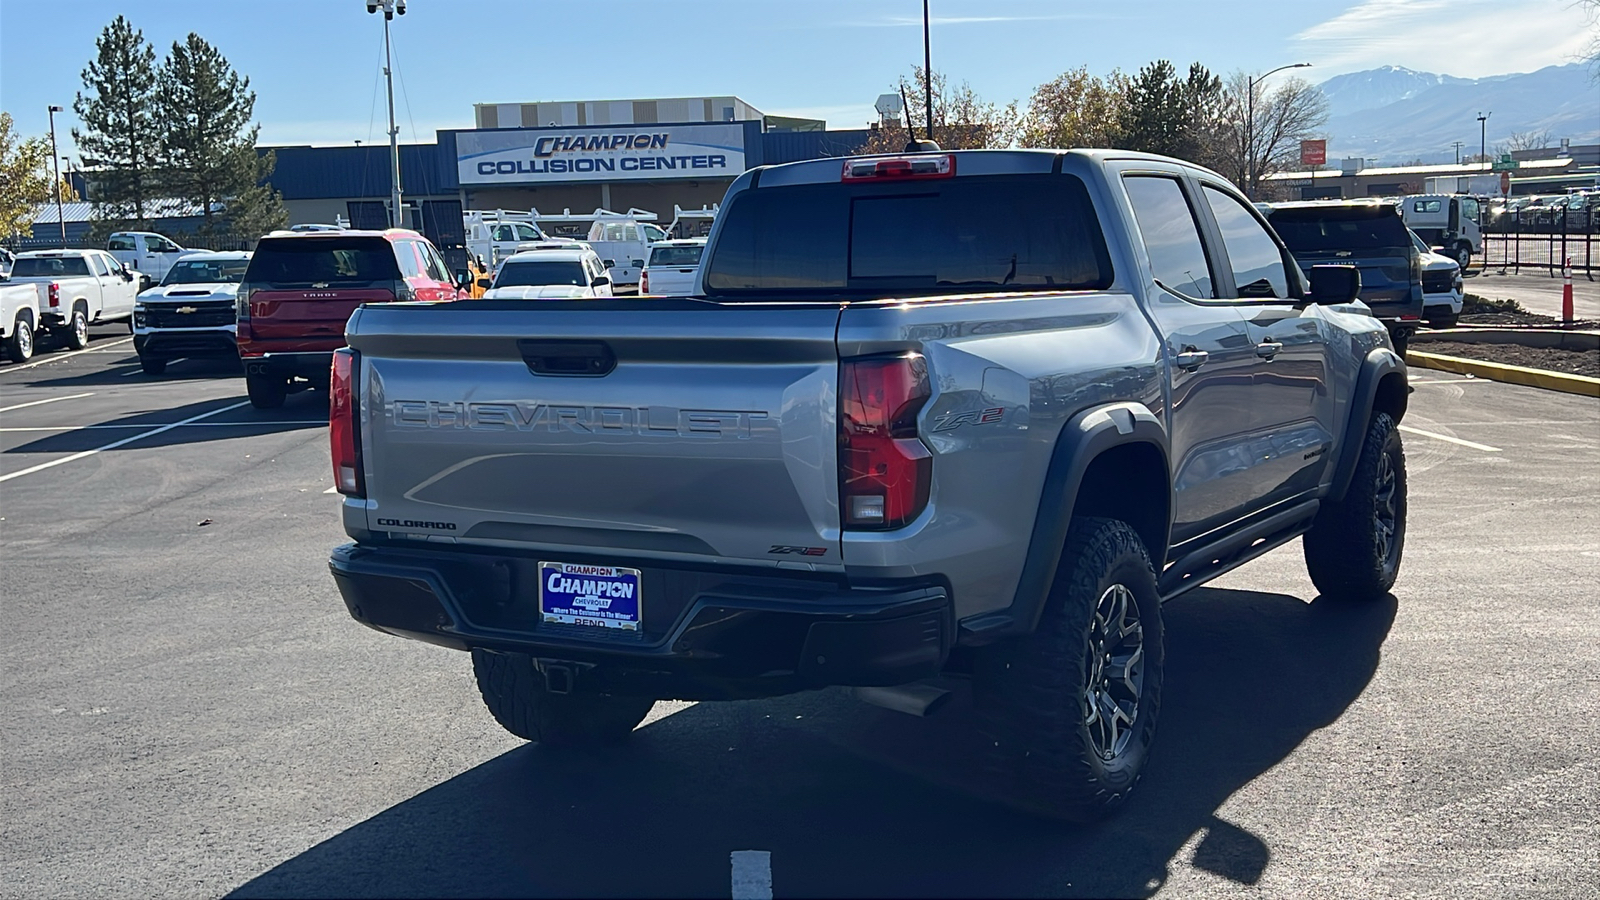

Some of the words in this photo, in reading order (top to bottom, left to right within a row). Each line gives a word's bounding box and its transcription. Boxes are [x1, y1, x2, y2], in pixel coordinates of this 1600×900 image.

[534, 133, 668, 157] CHAMPION
[477, 158, 615, 175] COLLISION
[620, 155, 726, 170] CENTER
[393, 400, 768, 440] CHEVROLET
[932, 407, 1004, 433] ZR2
[377, 518, 457, 530] COLORADO
[767, 544, 828, 556] ZR2
[565, 565, 613, 576] CHAMPION
[548, 573, 634, 598] CHAMPION
[575, 598, 609, 607] CHEVROLET
[574, 618, 606, 627] RENO
